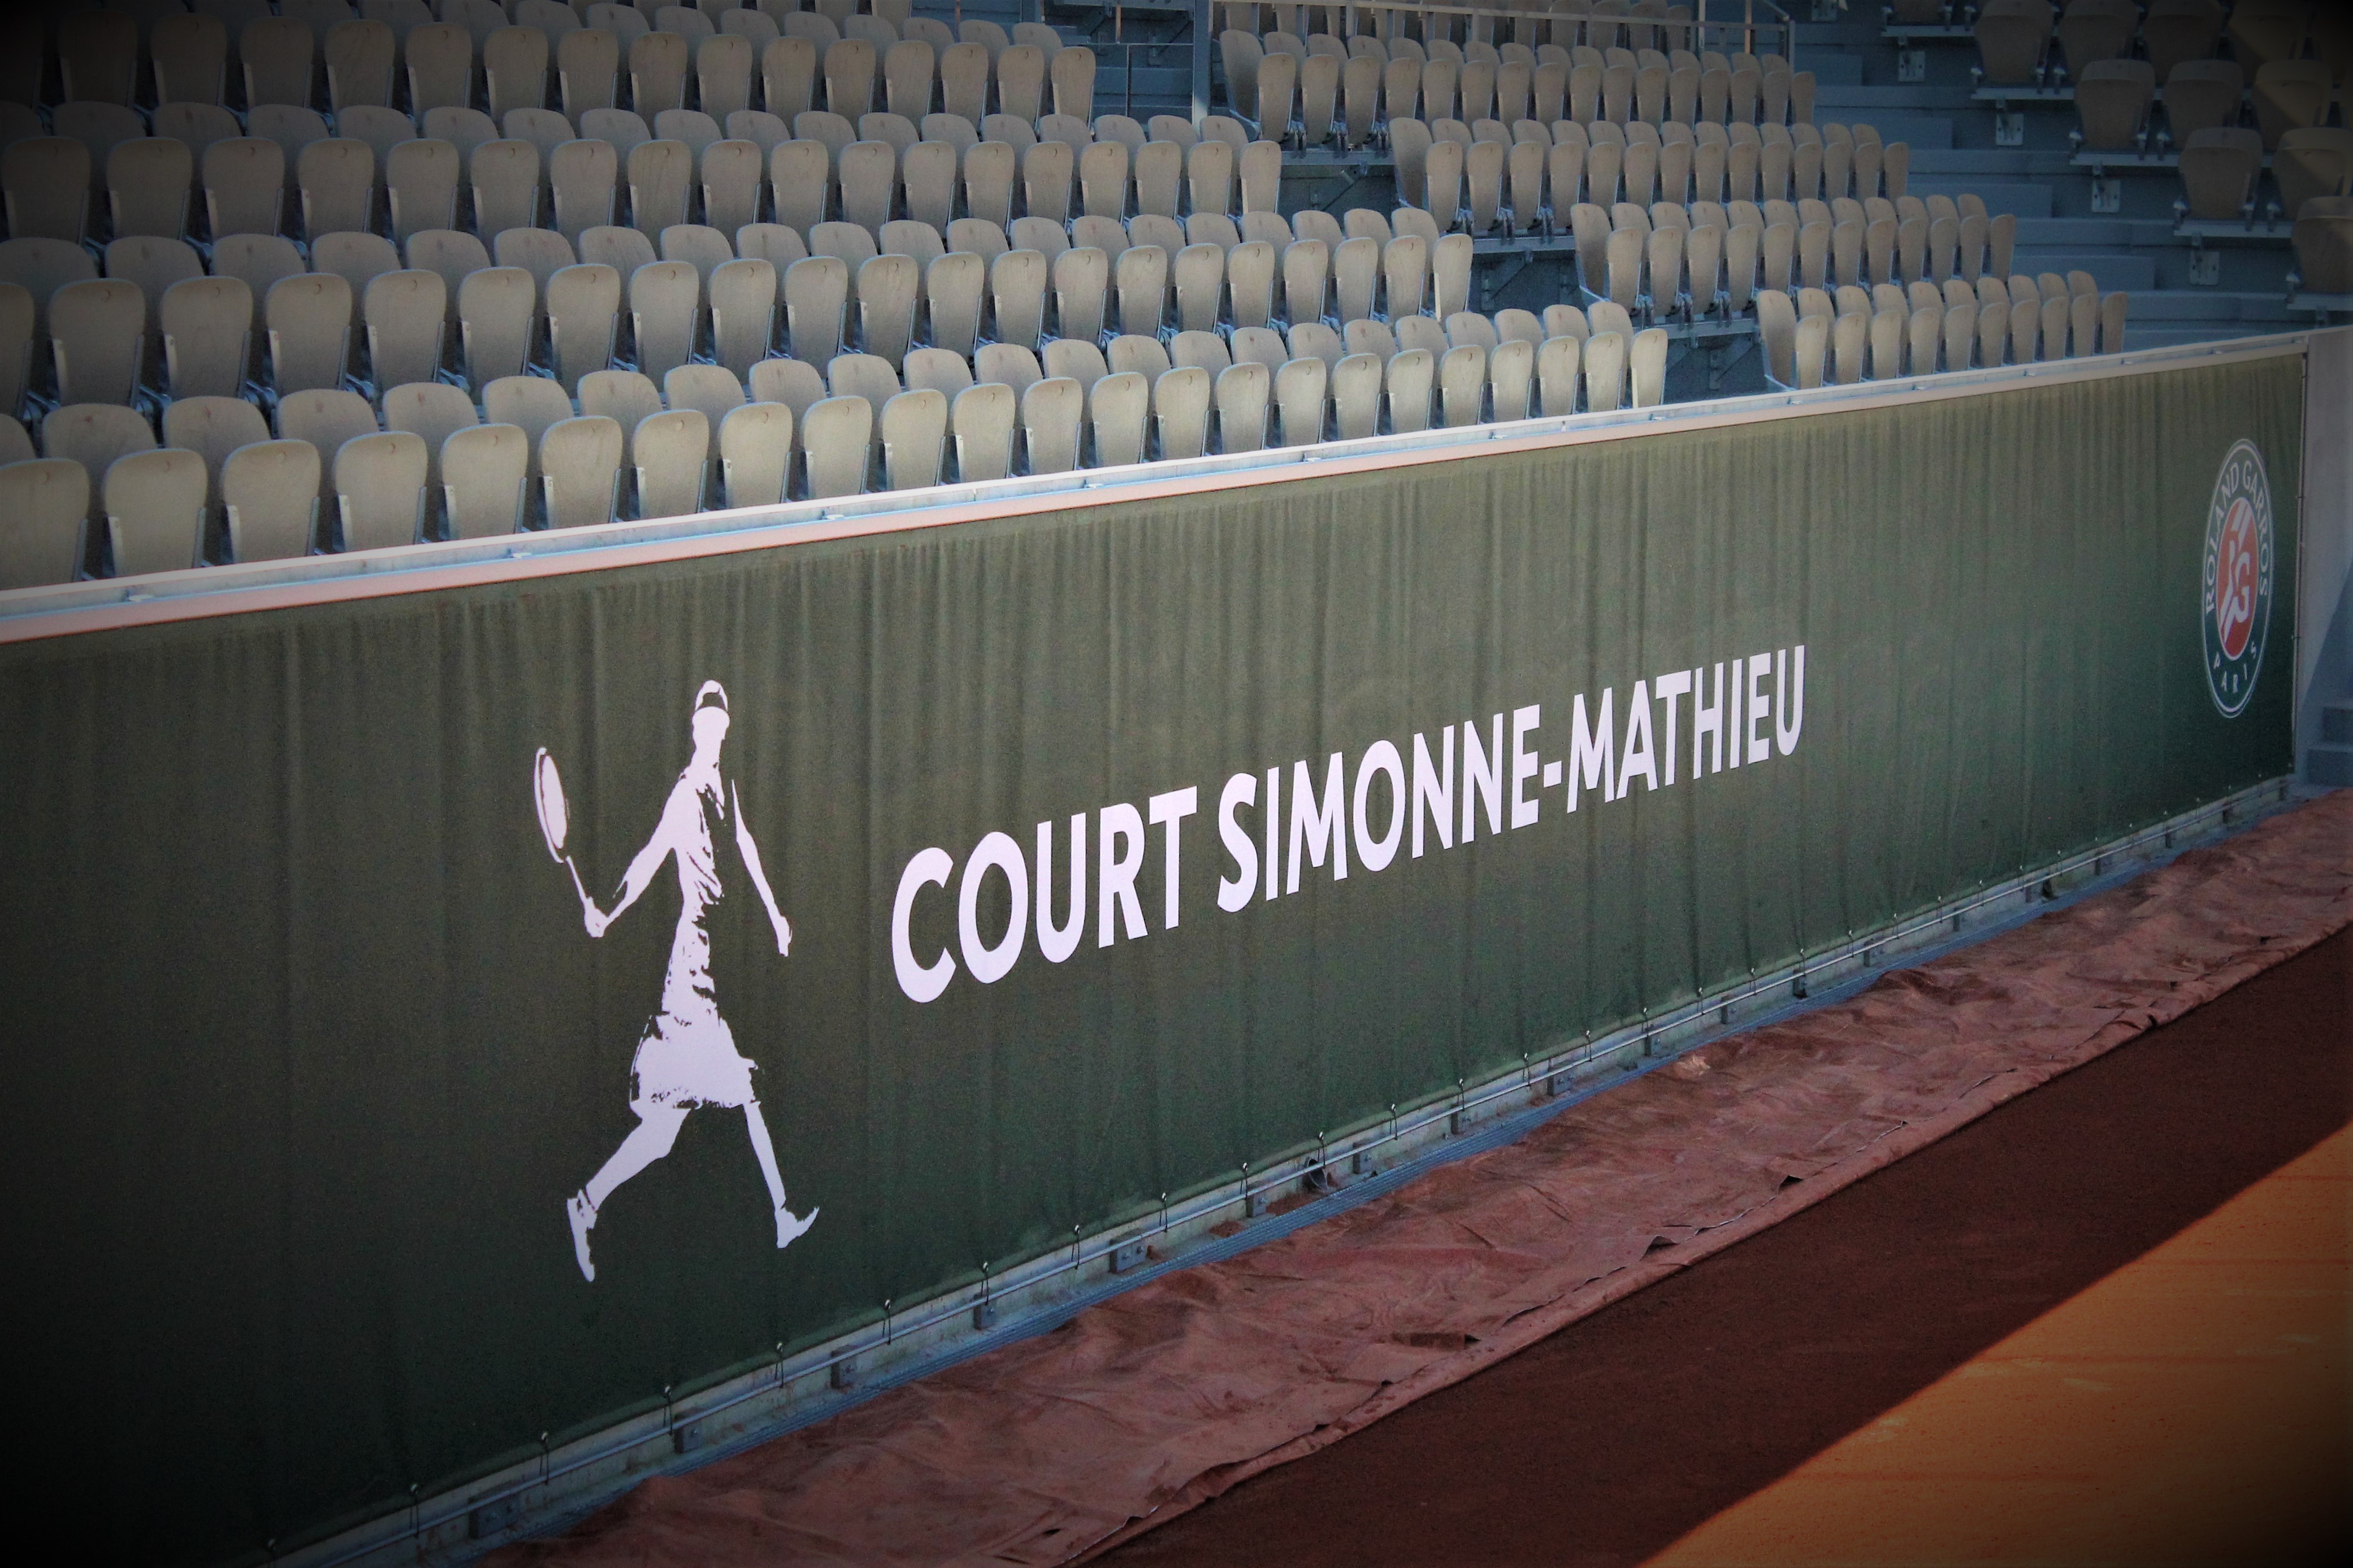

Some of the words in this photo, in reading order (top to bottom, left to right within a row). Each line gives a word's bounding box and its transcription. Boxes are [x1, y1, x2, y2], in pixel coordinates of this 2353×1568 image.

[2205, 462, 2240, 614] ROLAND
[2243, 459, 2269, 596] GARROS
[2213, 640, 2257, 693] PARIS
[891, 785, 1197, 1003] COURT
[1217, 645, 1805, 913] SIMONNE-MATHIEU
